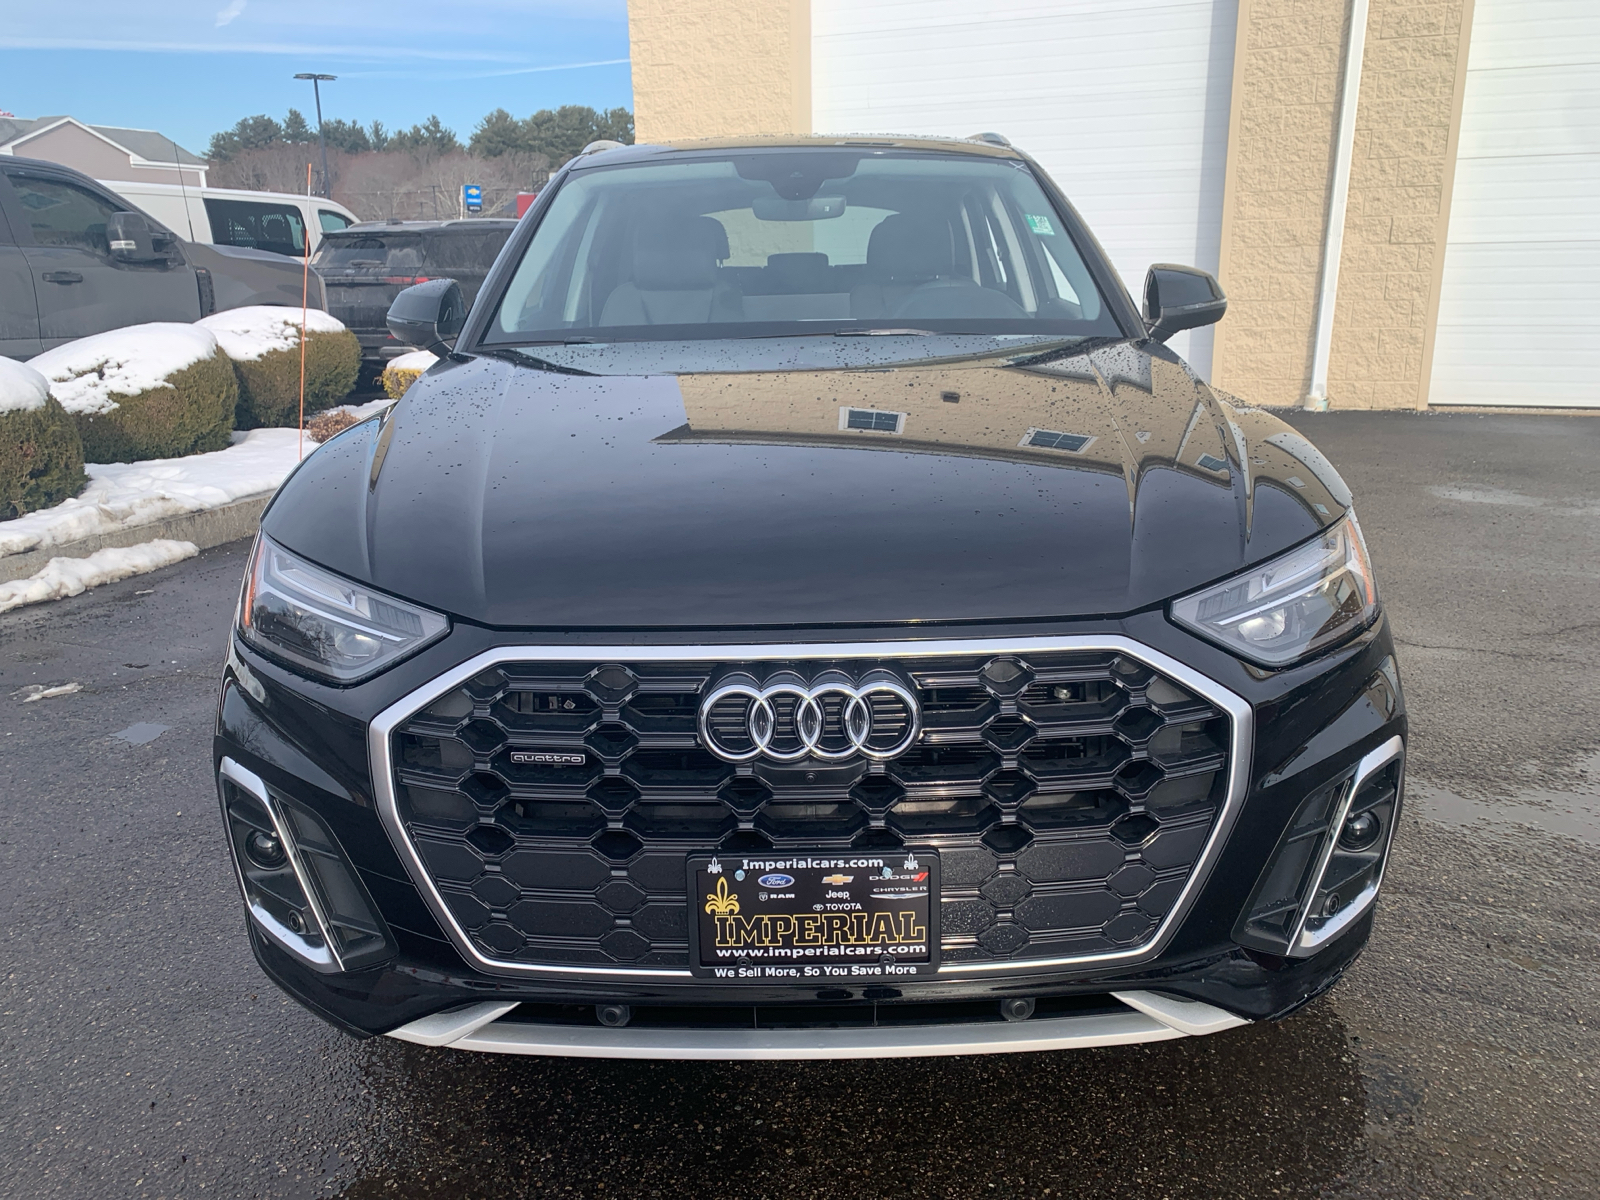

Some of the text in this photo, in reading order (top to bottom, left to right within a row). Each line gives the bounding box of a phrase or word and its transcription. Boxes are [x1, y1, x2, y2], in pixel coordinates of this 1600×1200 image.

[513, 755, 582, 763] quattro
[742, 857, 884, 871] Imperialcars.com
[825, 889, 850, 900] Jeep
[825, 902, 862, 911] TOYOTA
[715, 911, 926, 947] IMPERIAL
[716, 944, 926, 958] www.imperialcars.com
[715, 964, 917, 978] We Sell More, So You Save More
